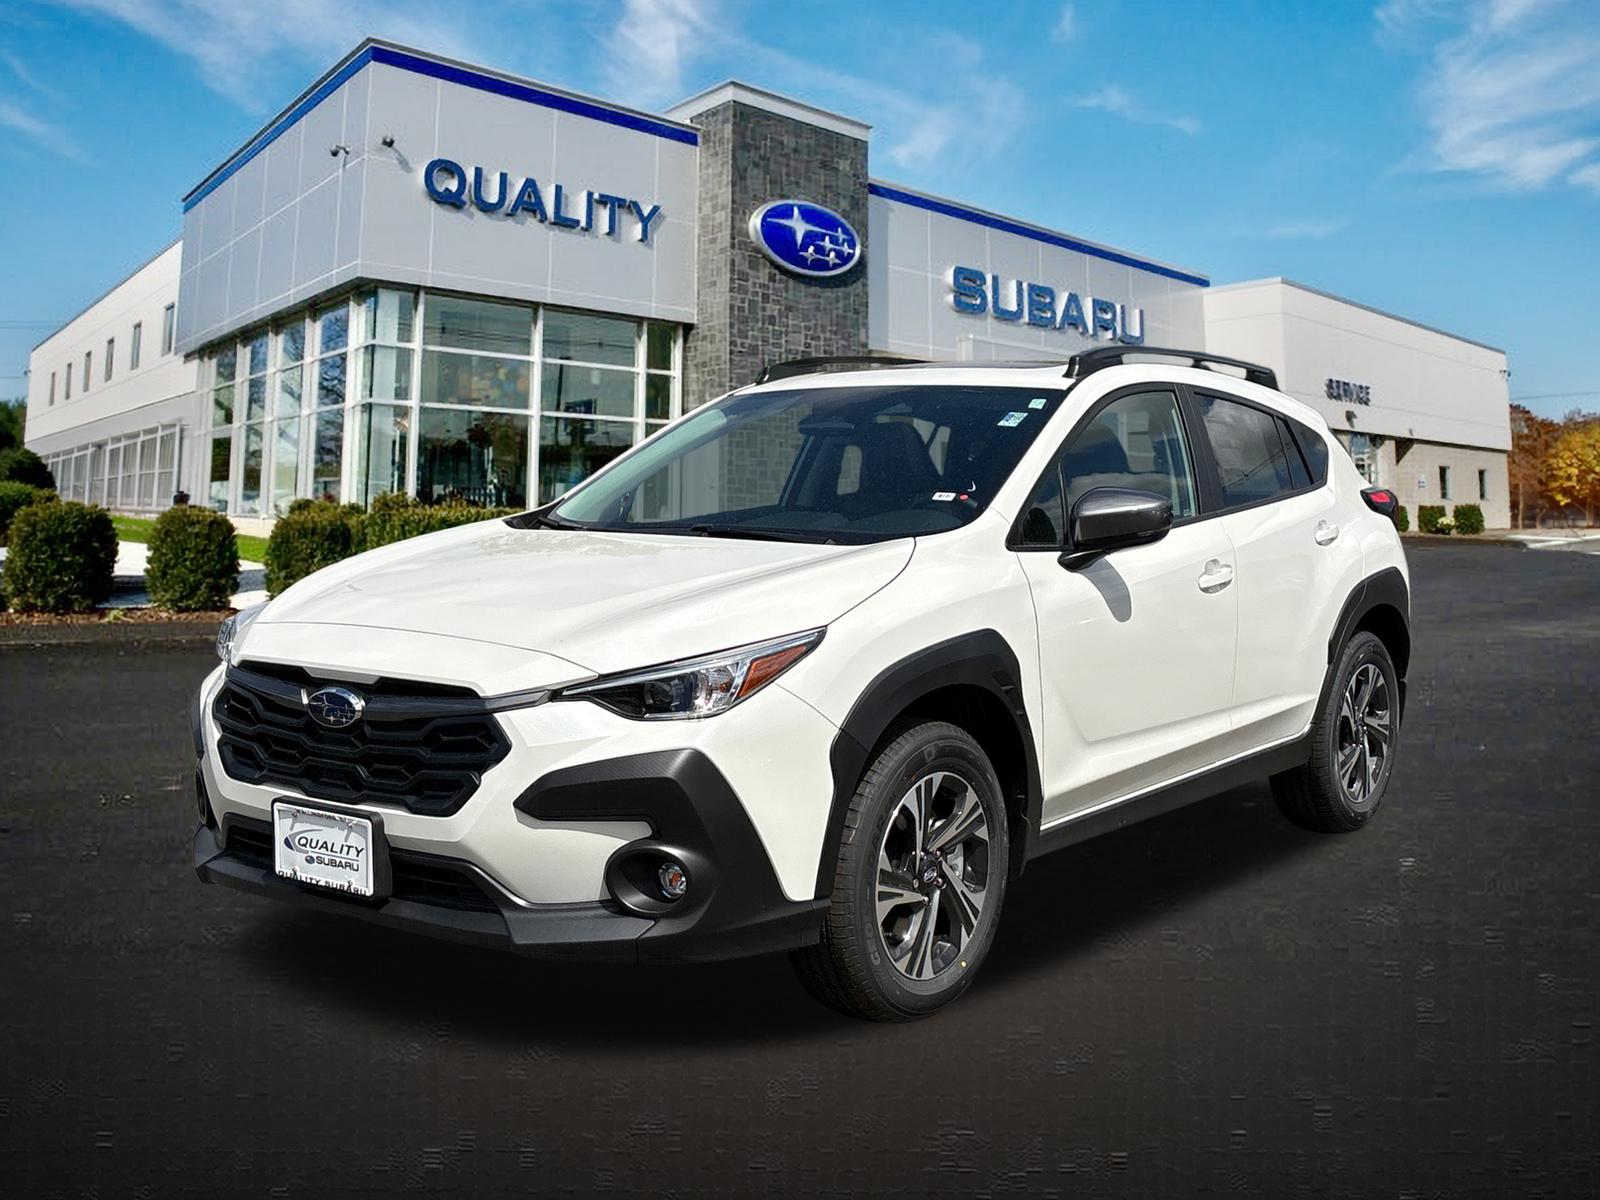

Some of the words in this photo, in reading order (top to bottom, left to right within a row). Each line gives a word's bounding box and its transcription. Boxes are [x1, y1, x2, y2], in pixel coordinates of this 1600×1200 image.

[424, 158, 661, 242] QUALITY
[949, 266, 1145, 345] SUBARU
[297, 836, 364, 858] QUALITY
[316, 855, 360, 872] SUBARU
